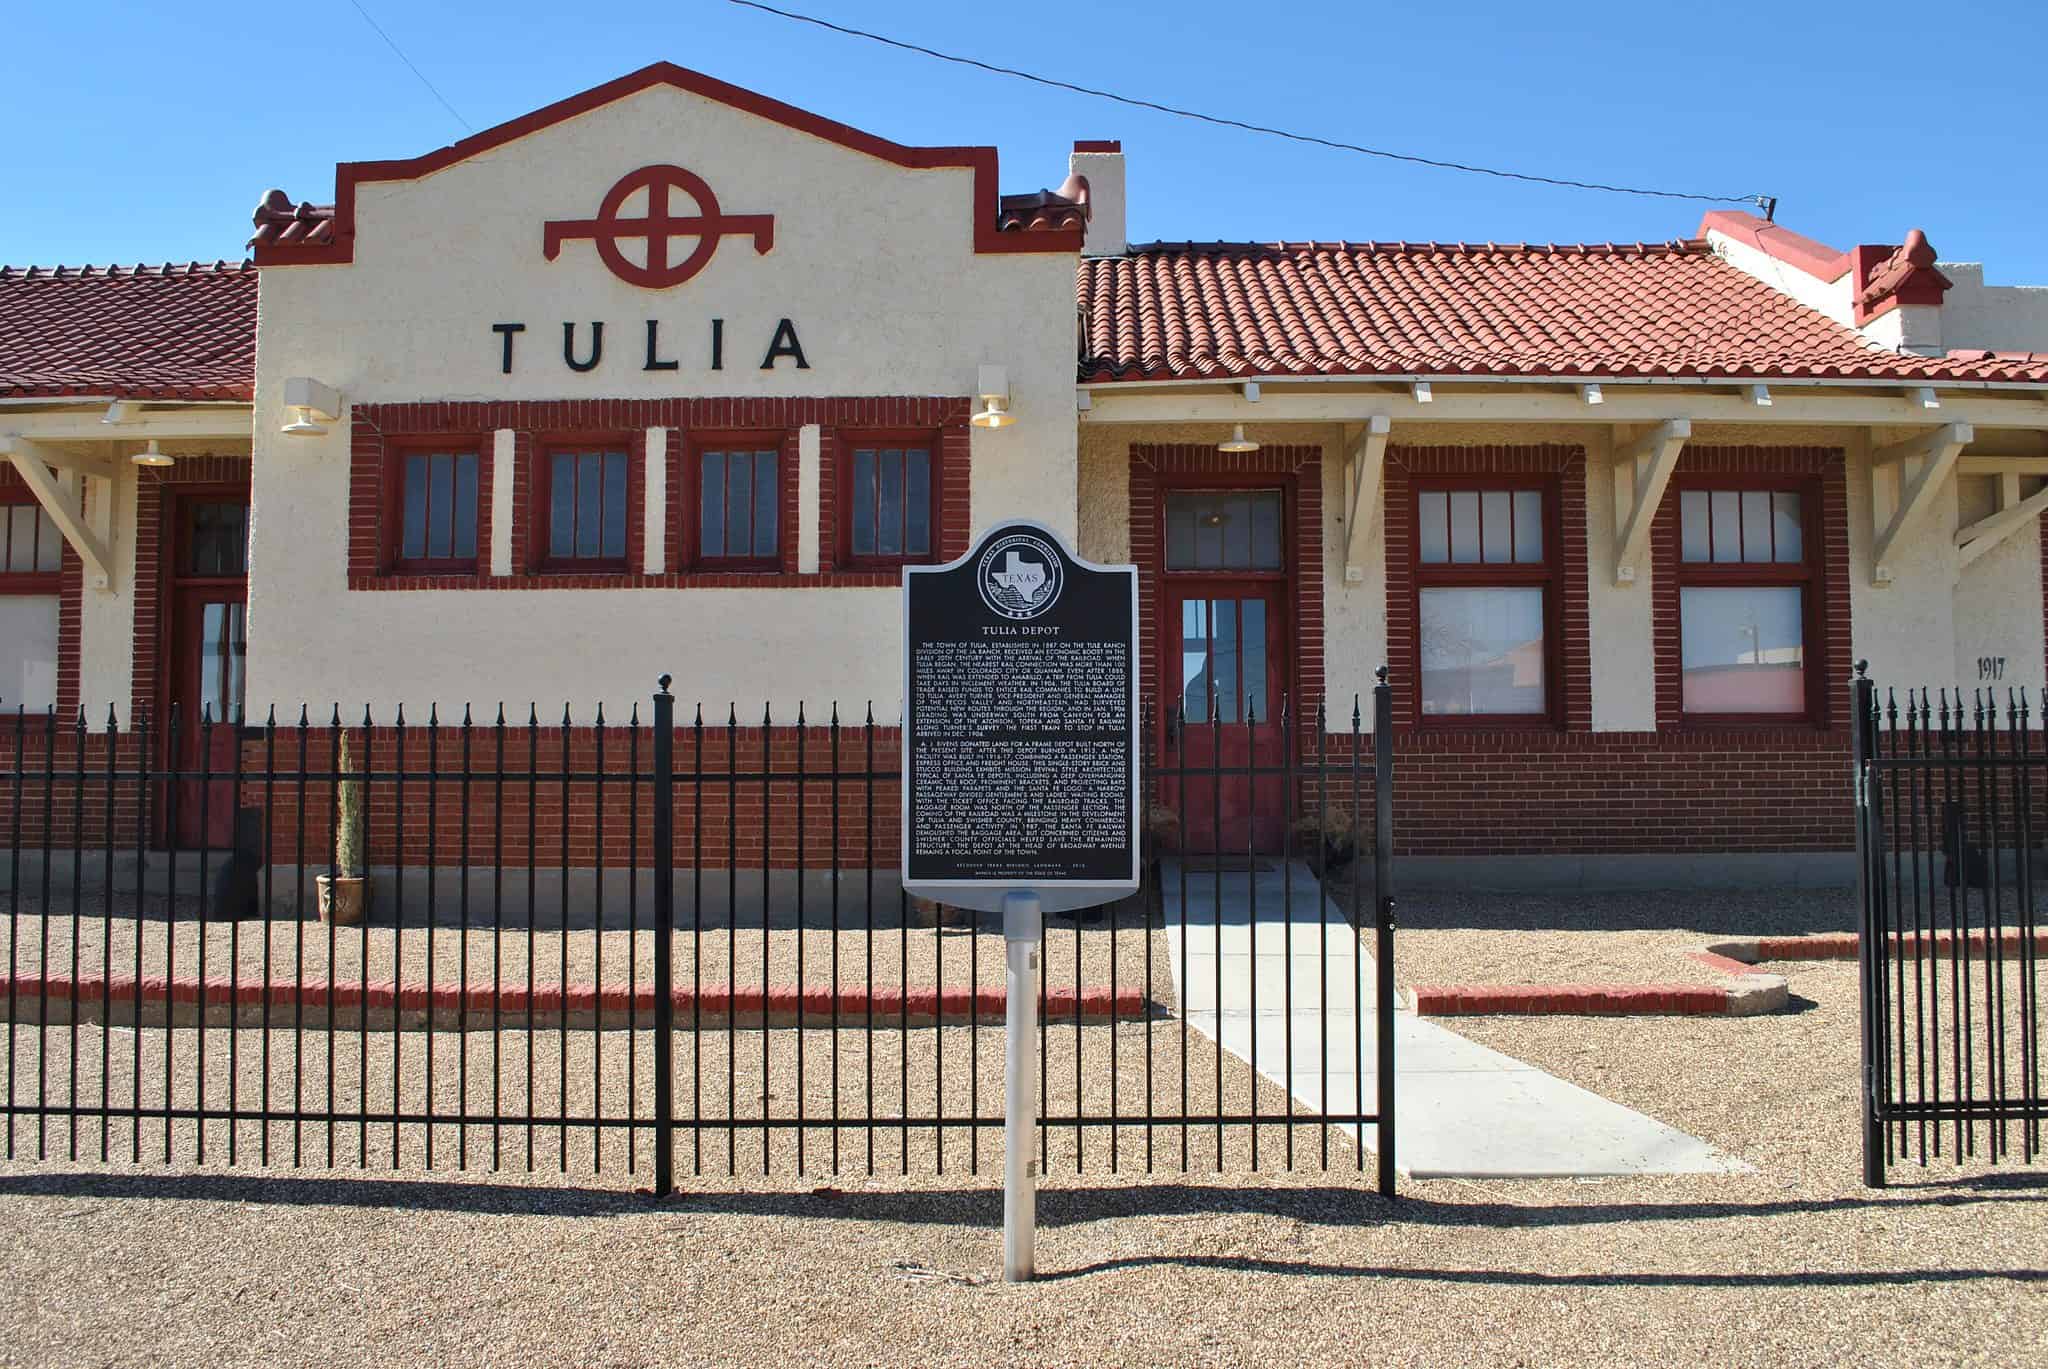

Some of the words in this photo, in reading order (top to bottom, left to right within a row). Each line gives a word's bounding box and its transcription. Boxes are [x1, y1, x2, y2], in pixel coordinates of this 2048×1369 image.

[492, 318, 810, 373] TULIA
[1002, 574, 1038, 584] TEXAS
[981, 626, 1017, 635] TULIA
[1022, 626, 1060, 635] DEPOT
[1977, 656, 2005, 680] 1917
